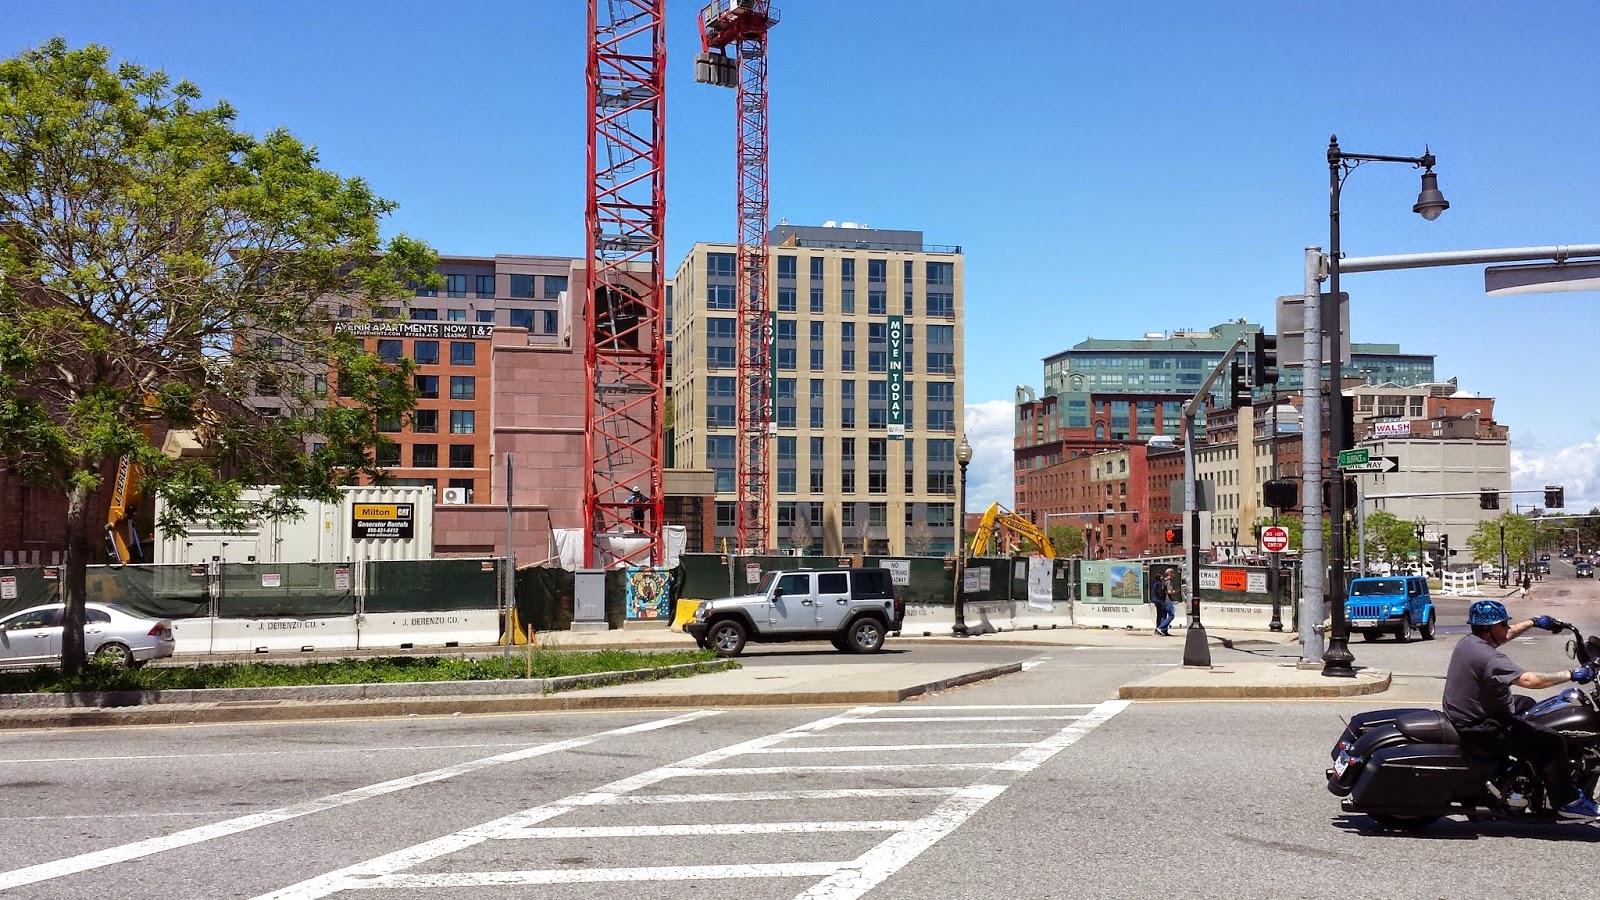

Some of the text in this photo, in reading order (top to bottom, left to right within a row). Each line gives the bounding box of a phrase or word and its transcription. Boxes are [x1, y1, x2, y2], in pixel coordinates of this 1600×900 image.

[334, 322, 438, 333] AVENIR APARTMENTS
[443, 325, 468, 333] NOW
[471, 325, 493, 336] 1 & 2
[890, 321, 900, 358] MOVE
[890, 361, 901, 370] IN
[890, 373, 900, 420] TODAY
[1347, 454, 1363, 464] SURFACE
[1366, 461, 1382, 469] WAY
[362, 508, 410, 516] Milton CAT
[258, 621, 318, 631] J. DERENZO CO.
[402, 616, 460, 627] J. DERENZO CO.
